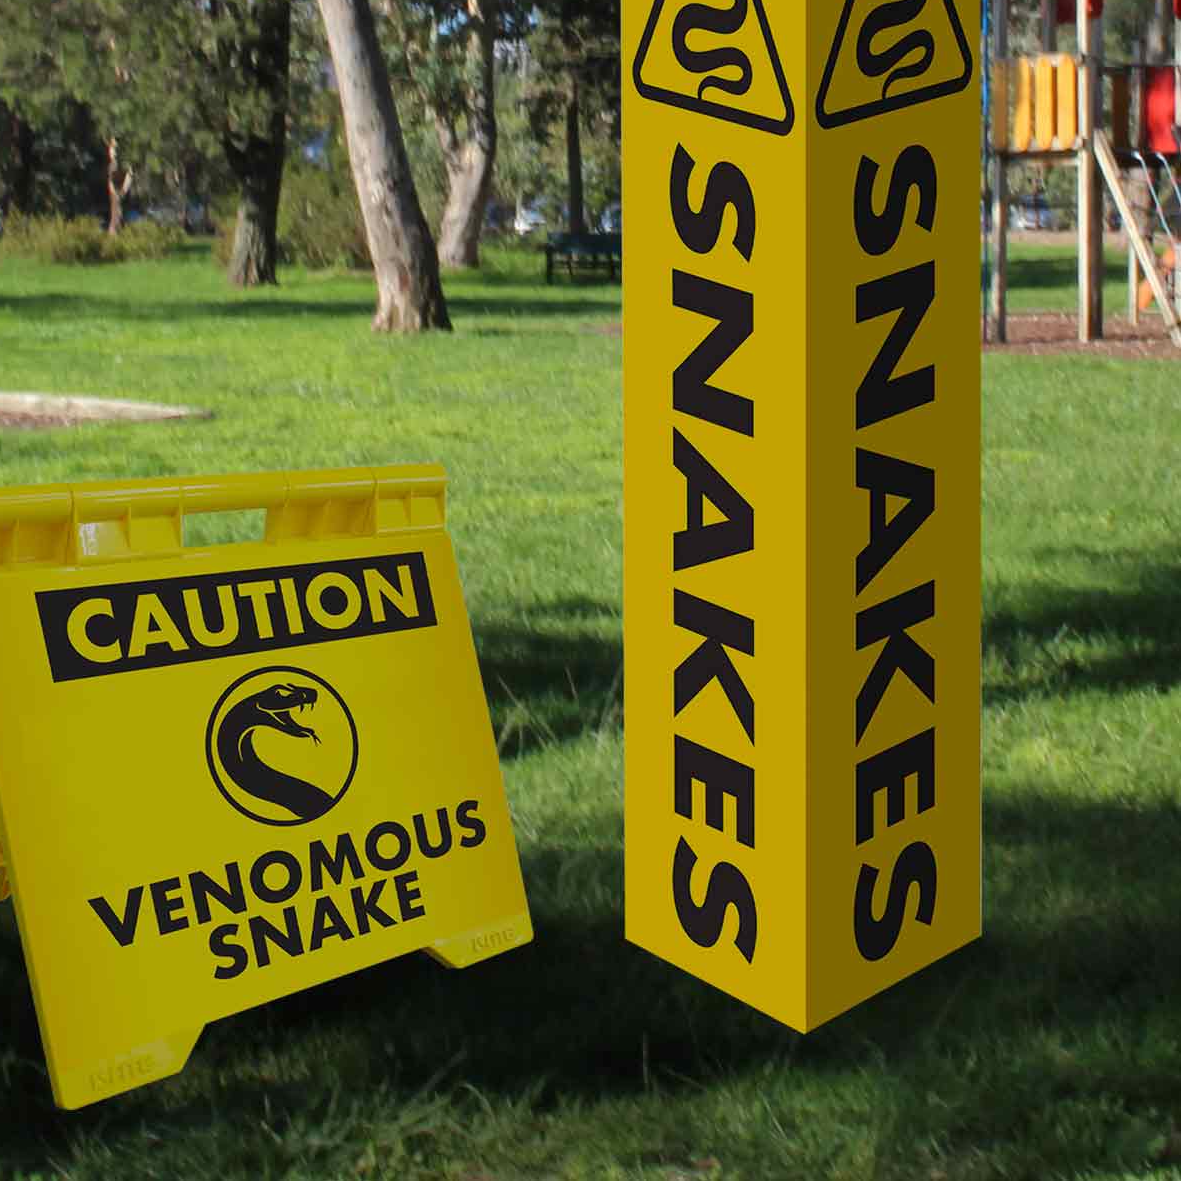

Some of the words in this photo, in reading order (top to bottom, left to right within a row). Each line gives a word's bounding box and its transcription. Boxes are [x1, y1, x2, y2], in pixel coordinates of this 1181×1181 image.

[66, 565, 419, 663] CAUTION
[670, 143, 757, 964] SNAKES
[854, 145, 937, 962] SNAKES
[87, 800, 486, 947] VENOMOUS
[209, 871, 426, 980] SNAKE
